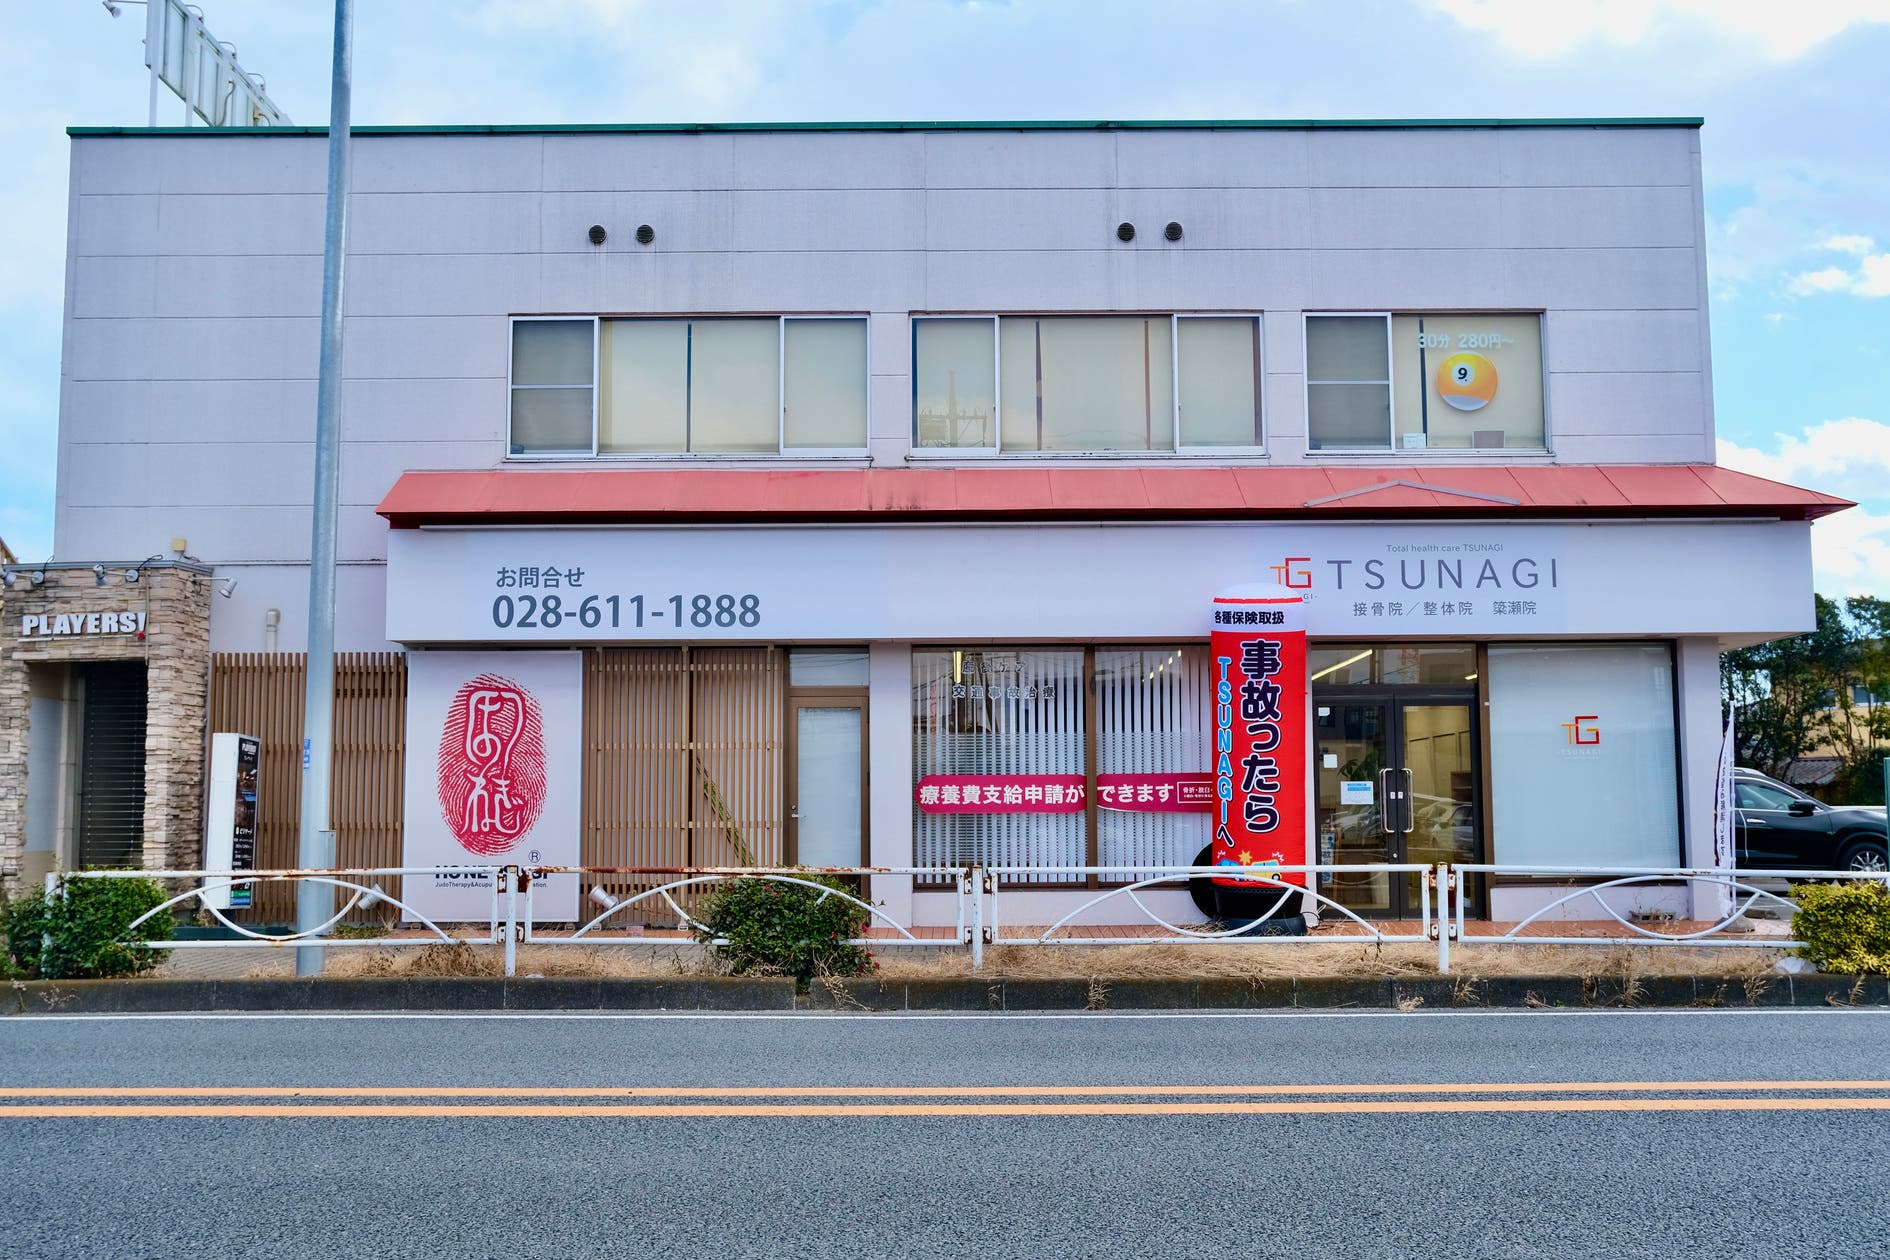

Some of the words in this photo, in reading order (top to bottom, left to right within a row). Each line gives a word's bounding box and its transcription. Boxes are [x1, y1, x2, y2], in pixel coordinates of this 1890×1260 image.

[1386, 544, 1409, 553] Total
[1411, 544, 1439, 553] health
[1441, 545, 1461, 553] care
[1463, 543, 1504, 553] TSUNAGI
[495, 566, 586, 589] お問合せ
[1326, 557, 1557, 590] TSUNAGI
[492, 593, 761, 629] 028-611-1888
[1214, 610, 1285, 625] 各種保険取扱
[22, 611, 147, 641] PLAYERS!
[952, 685, 1056, 699] 交通事故治療
[1240, 638, 1282, 833] 事故ったら
[919, 784, 1086, 805] 療養費支給申請が
[1098, 784, 1174, 804] できます
